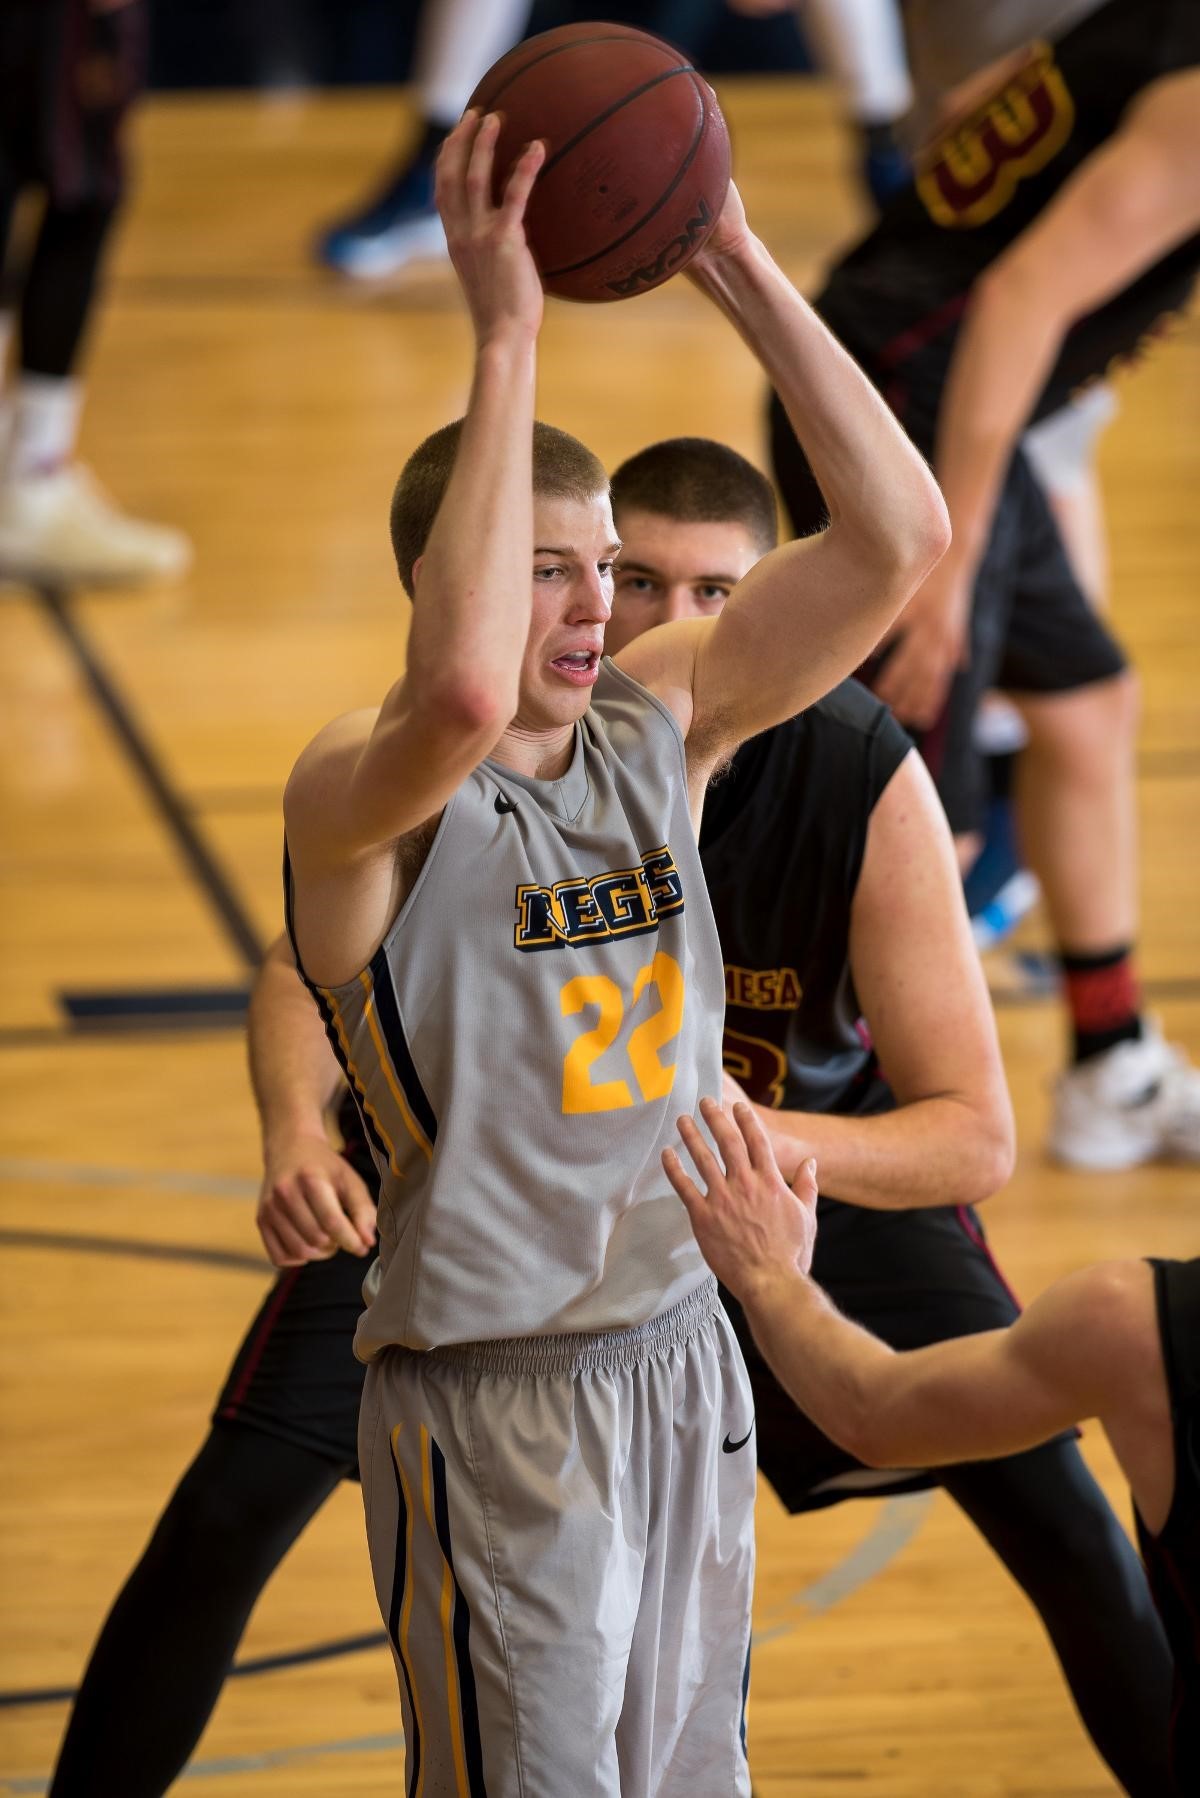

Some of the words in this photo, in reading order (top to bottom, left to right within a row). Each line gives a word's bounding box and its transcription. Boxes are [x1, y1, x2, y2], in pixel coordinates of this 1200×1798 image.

[605, 198, 711, 295] NCAA
[513, 844, 685, 952] REGS
[559, 951, 684, 1115] 22
